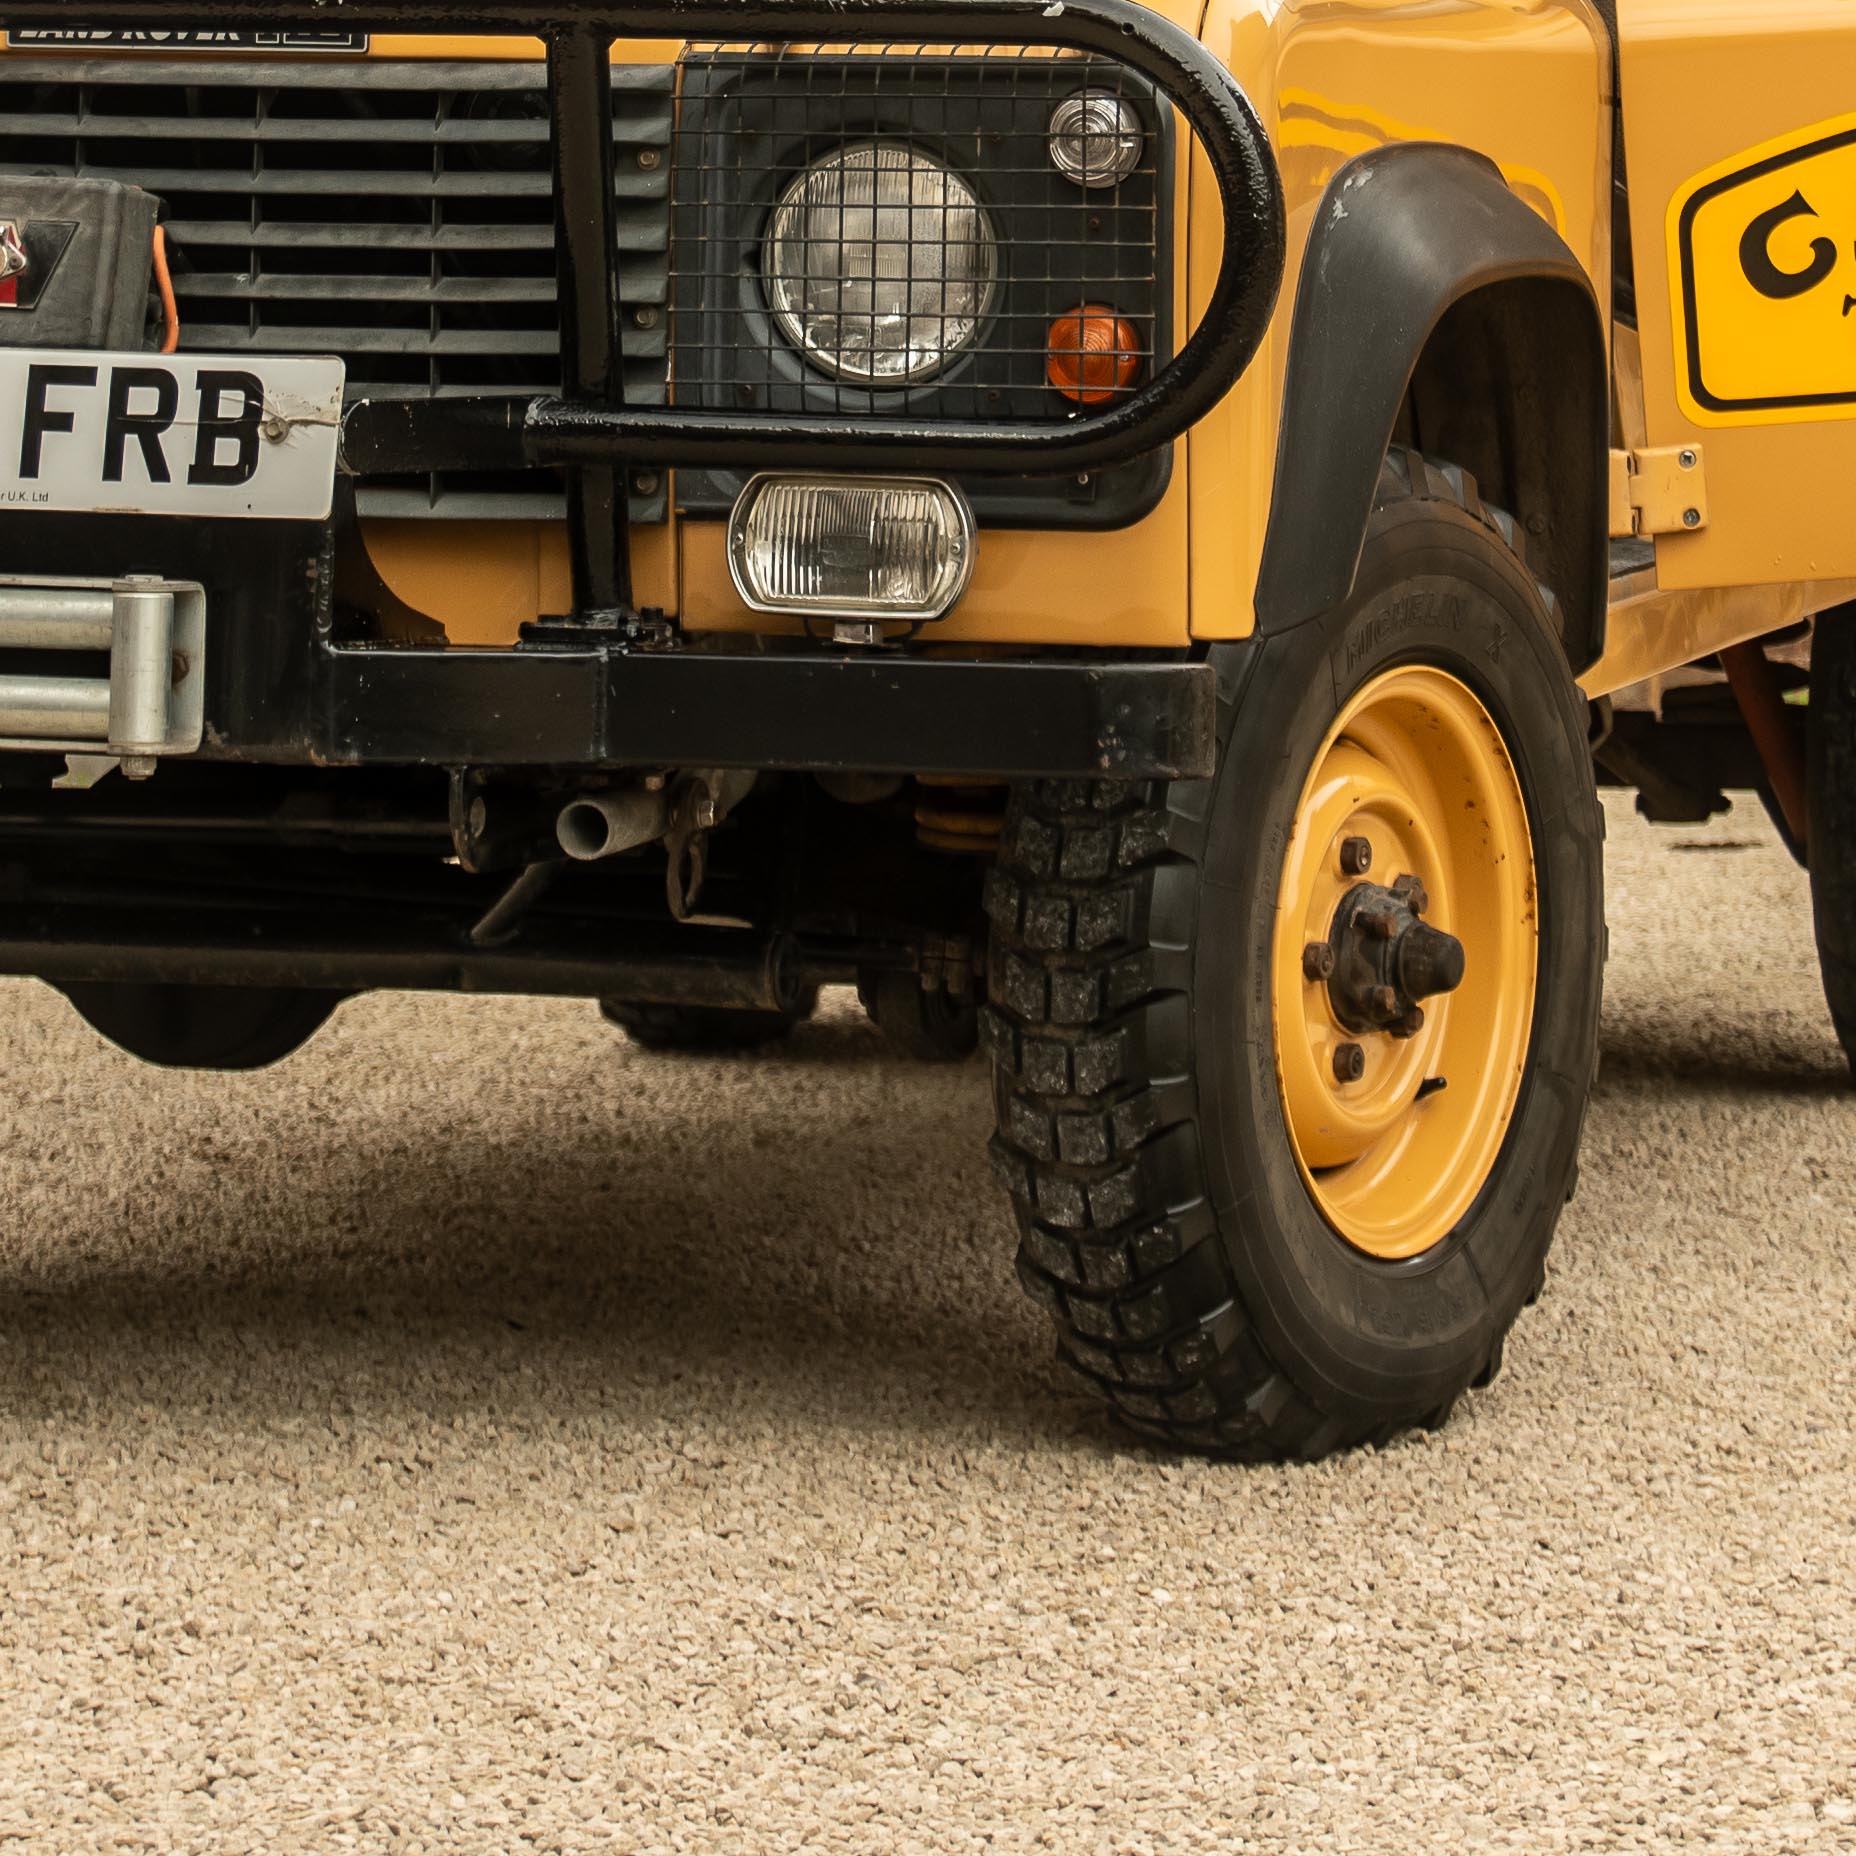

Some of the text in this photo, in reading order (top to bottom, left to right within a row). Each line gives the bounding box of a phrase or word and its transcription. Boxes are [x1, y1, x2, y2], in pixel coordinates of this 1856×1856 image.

[18, 364, 265, 487] FRB
[7, 491, 29, 502] U.K.
[32, 491, 49, 503] Ltd
